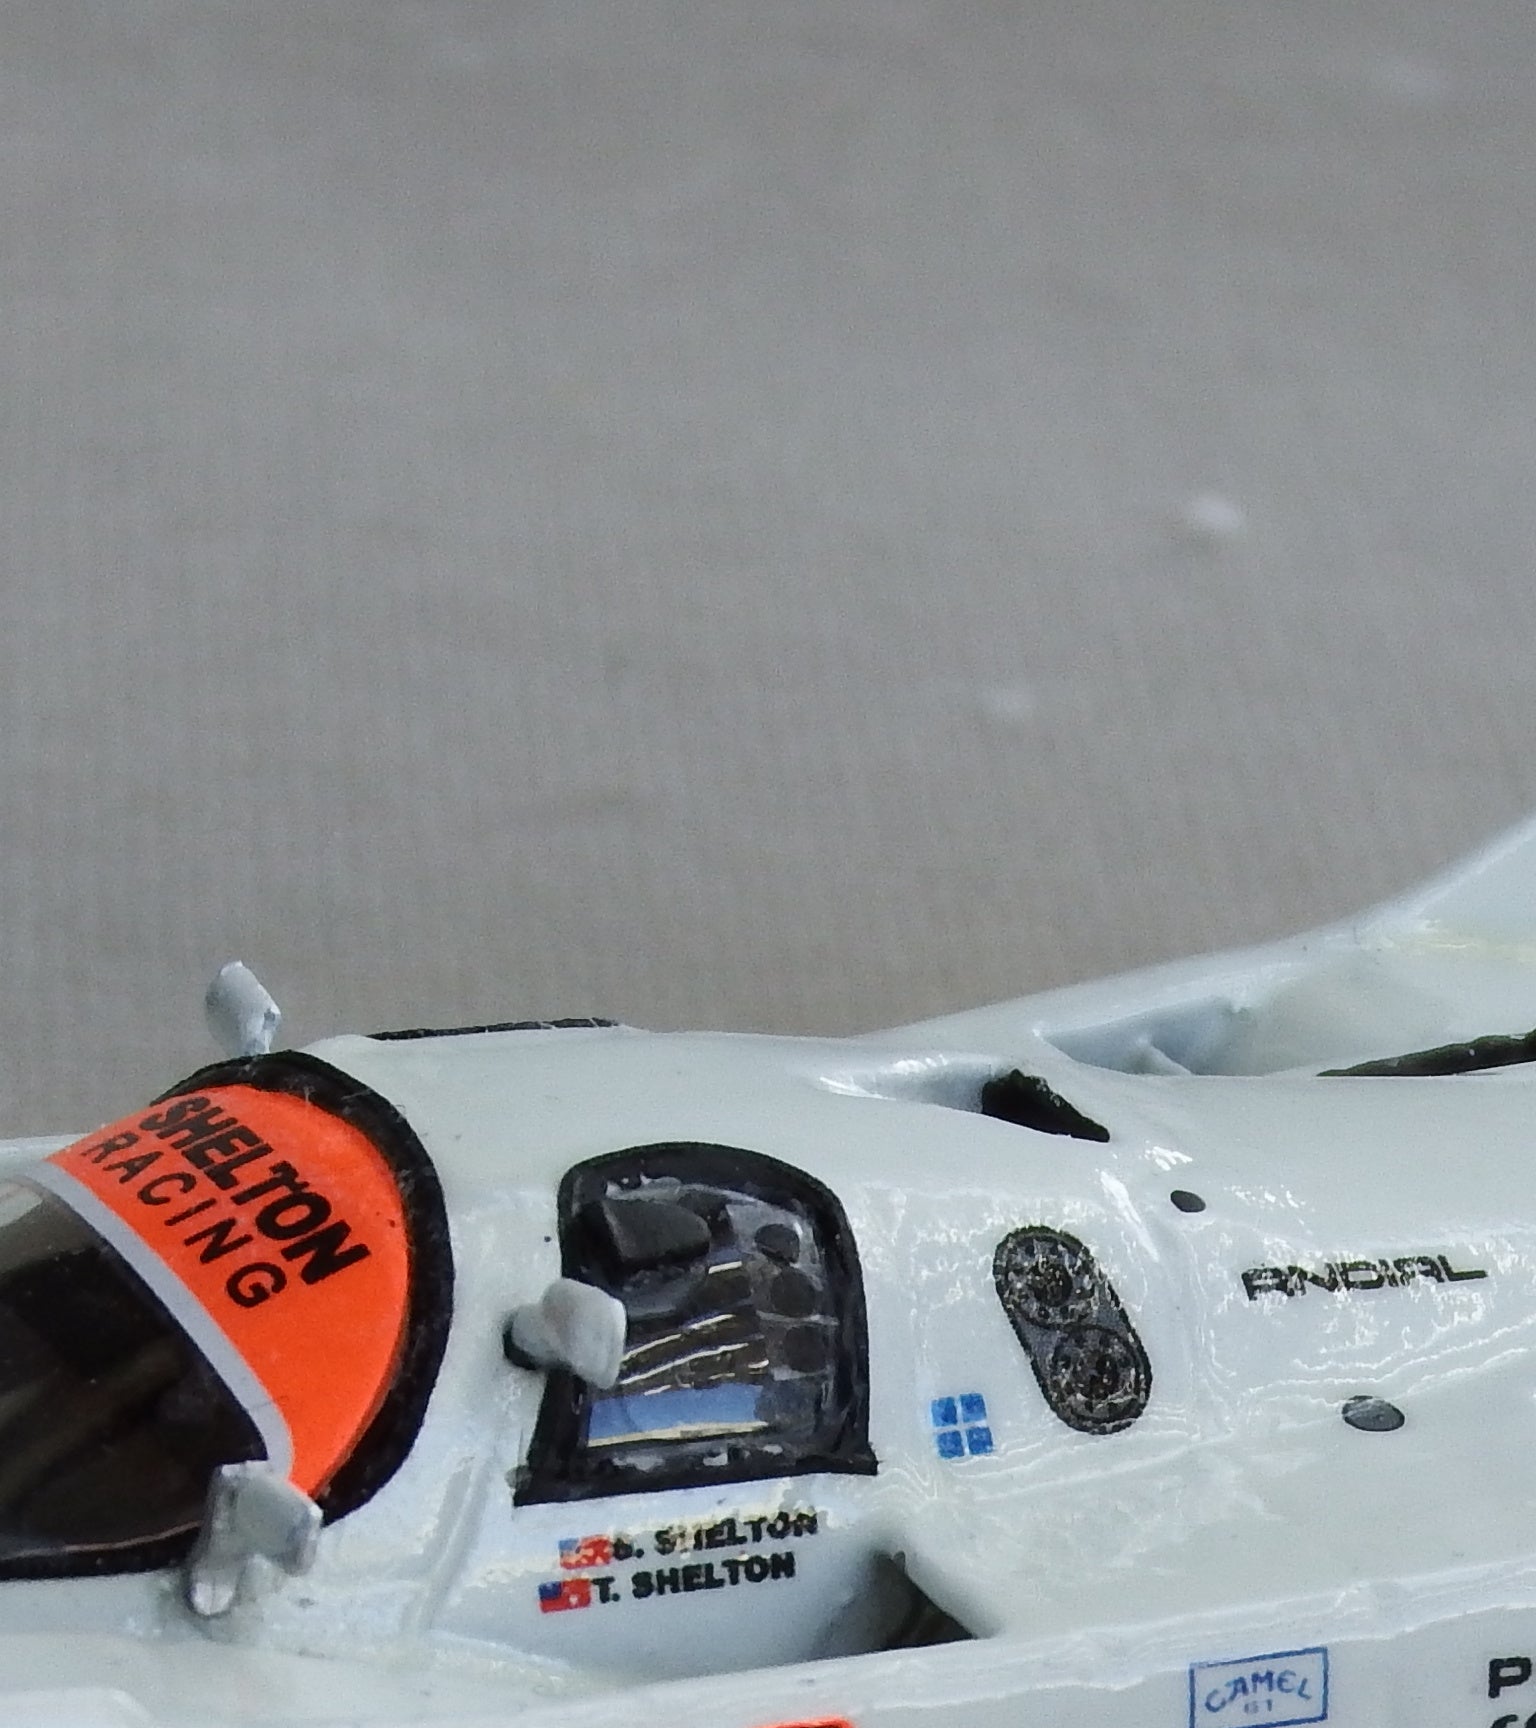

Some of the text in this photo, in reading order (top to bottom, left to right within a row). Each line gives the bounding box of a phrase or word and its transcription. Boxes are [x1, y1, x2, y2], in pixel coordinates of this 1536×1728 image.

[81, 1131, 287, 1308] RACING
[140, 1096, 372, 1286] SHELTON
[591, 1550, 796, 1604] T. SHELTON
[1204, 1668, 1312, 1713] CAMEL
